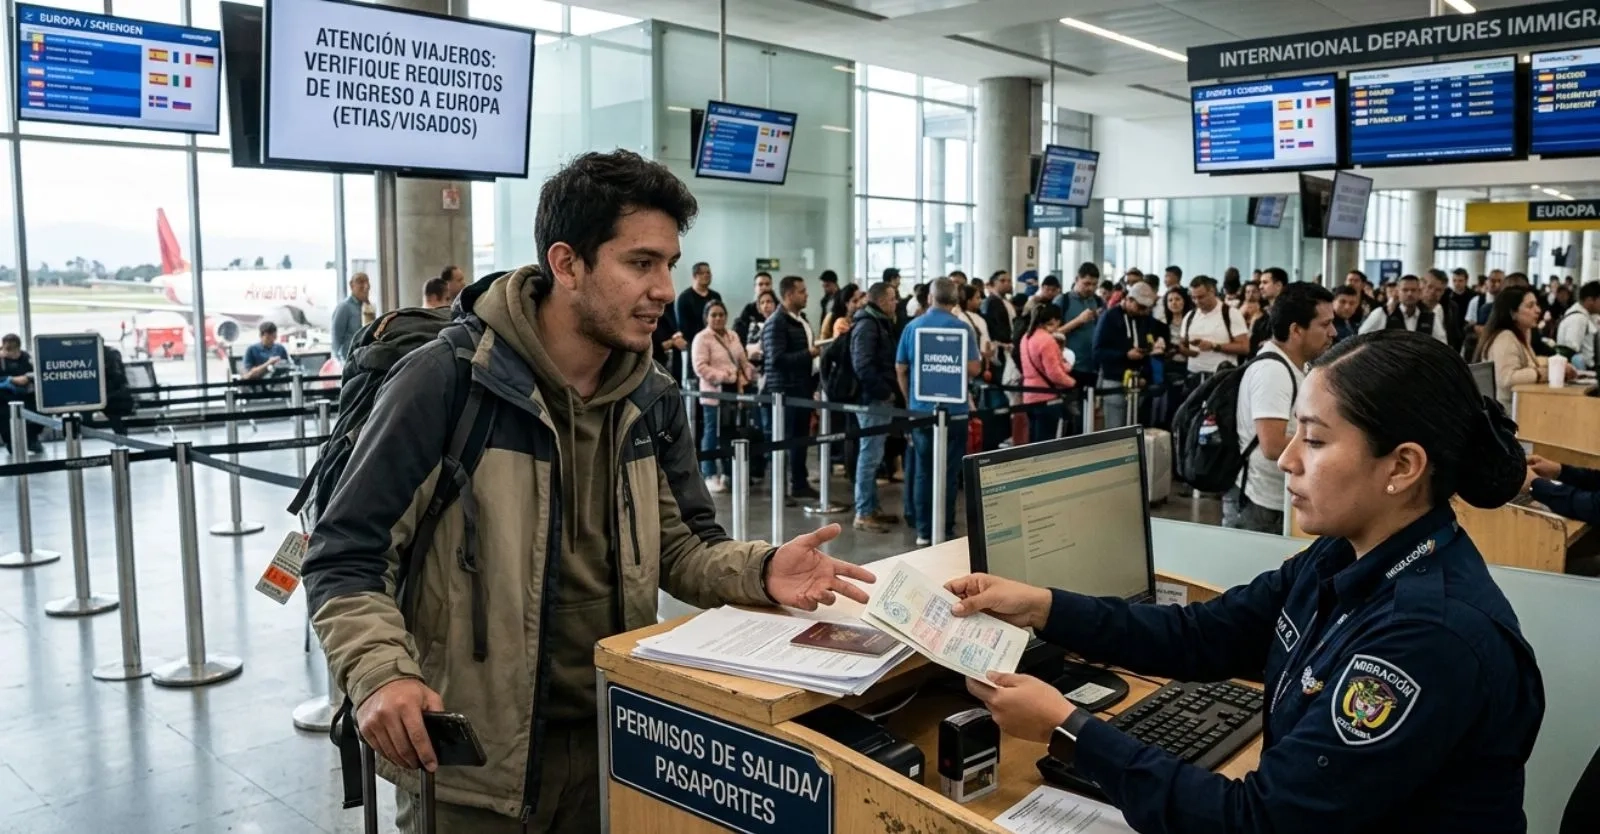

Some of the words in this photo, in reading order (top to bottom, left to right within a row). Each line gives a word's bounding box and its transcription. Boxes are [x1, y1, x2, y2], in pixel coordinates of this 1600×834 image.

[316, 27, 406, 57] ATENCIÓN
[411, 40, 496, 69] VIAJEROS:
[1220, 37, 1363, 68] INTERNATIONAL
[1367, 19, 1501, 51] DEPARTURES
[1507, 8, 1600, 36] IMMIGR
[304, 51, 400, 80] VERIFIQUE
[405, 64, 503, 92] REQUISITOS
[306, 77, 330, 98] DE
[336, 80, 414, 106] INGRESO
[420, 90, 431, 108] A
[436, 92, 500, 115] EUROPA
[333, 106, 477, 140] (ETIAS/VISADOS)
[1536, 204, 1597, 217] EUROPA
[45, 360, 87, 370] EUROPA
[616, 705, 706, 760] PERMISOS
[711, 739, 736, 772] DE
[741, 751, 823, 803] SALIDA/
[655, 756, 776, 825] PASAPORTES
